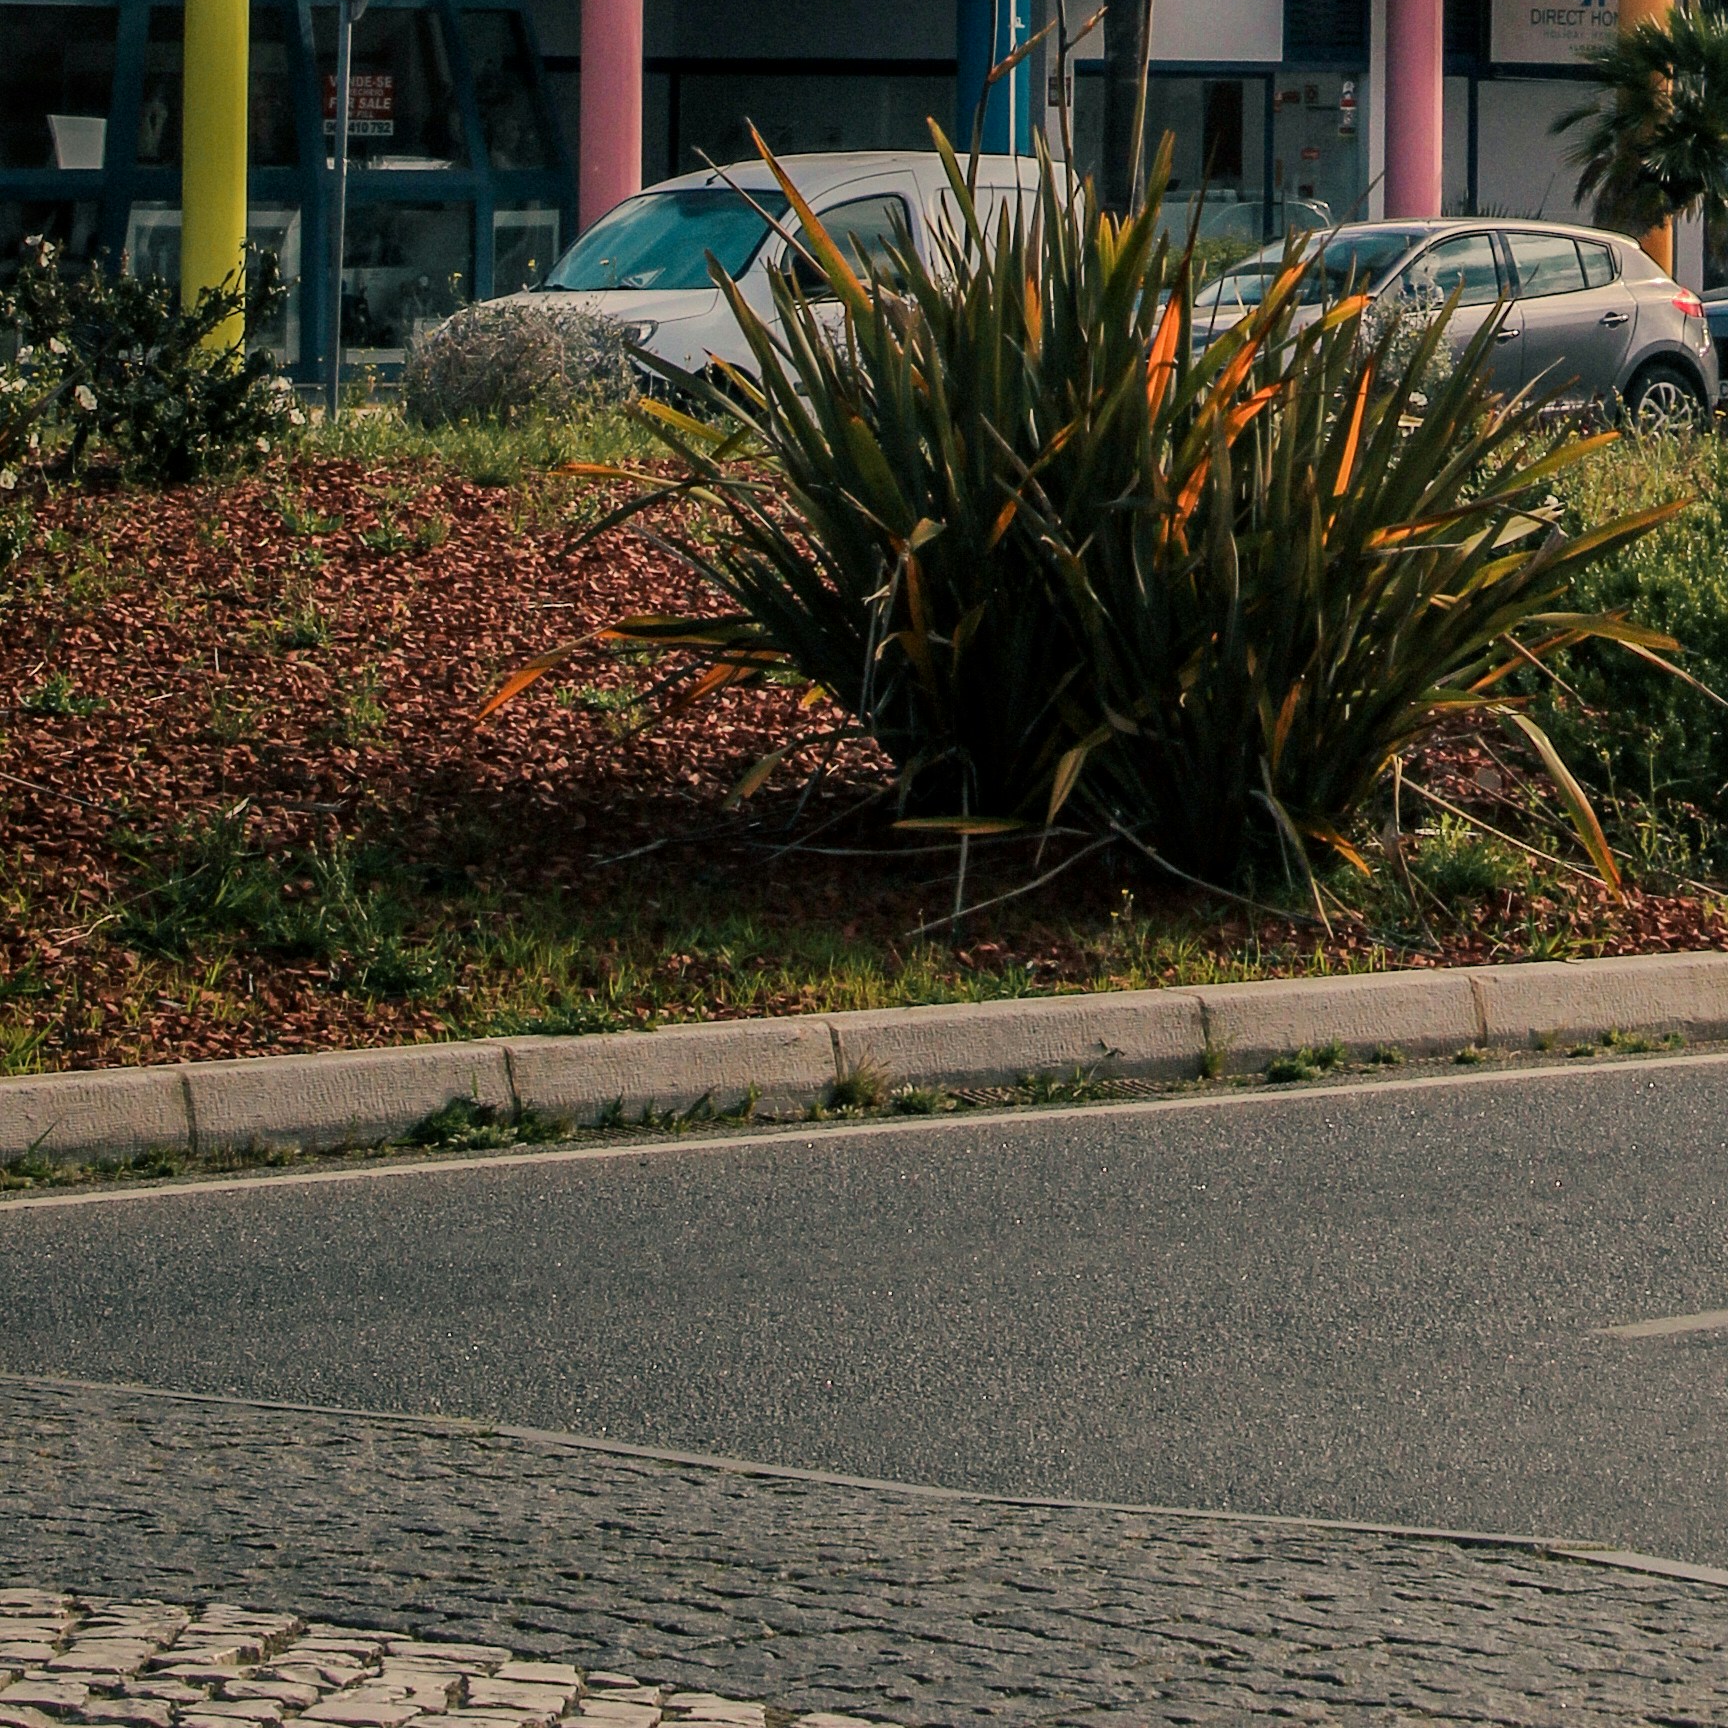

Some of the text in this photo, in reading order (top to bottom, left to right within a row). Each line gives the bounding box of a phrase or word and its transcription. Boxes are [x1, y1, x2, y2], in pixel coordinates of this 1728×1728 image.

[1531, 8, 1586, 25] DIRECT
[328, 97, 392, 110] FR SALE
